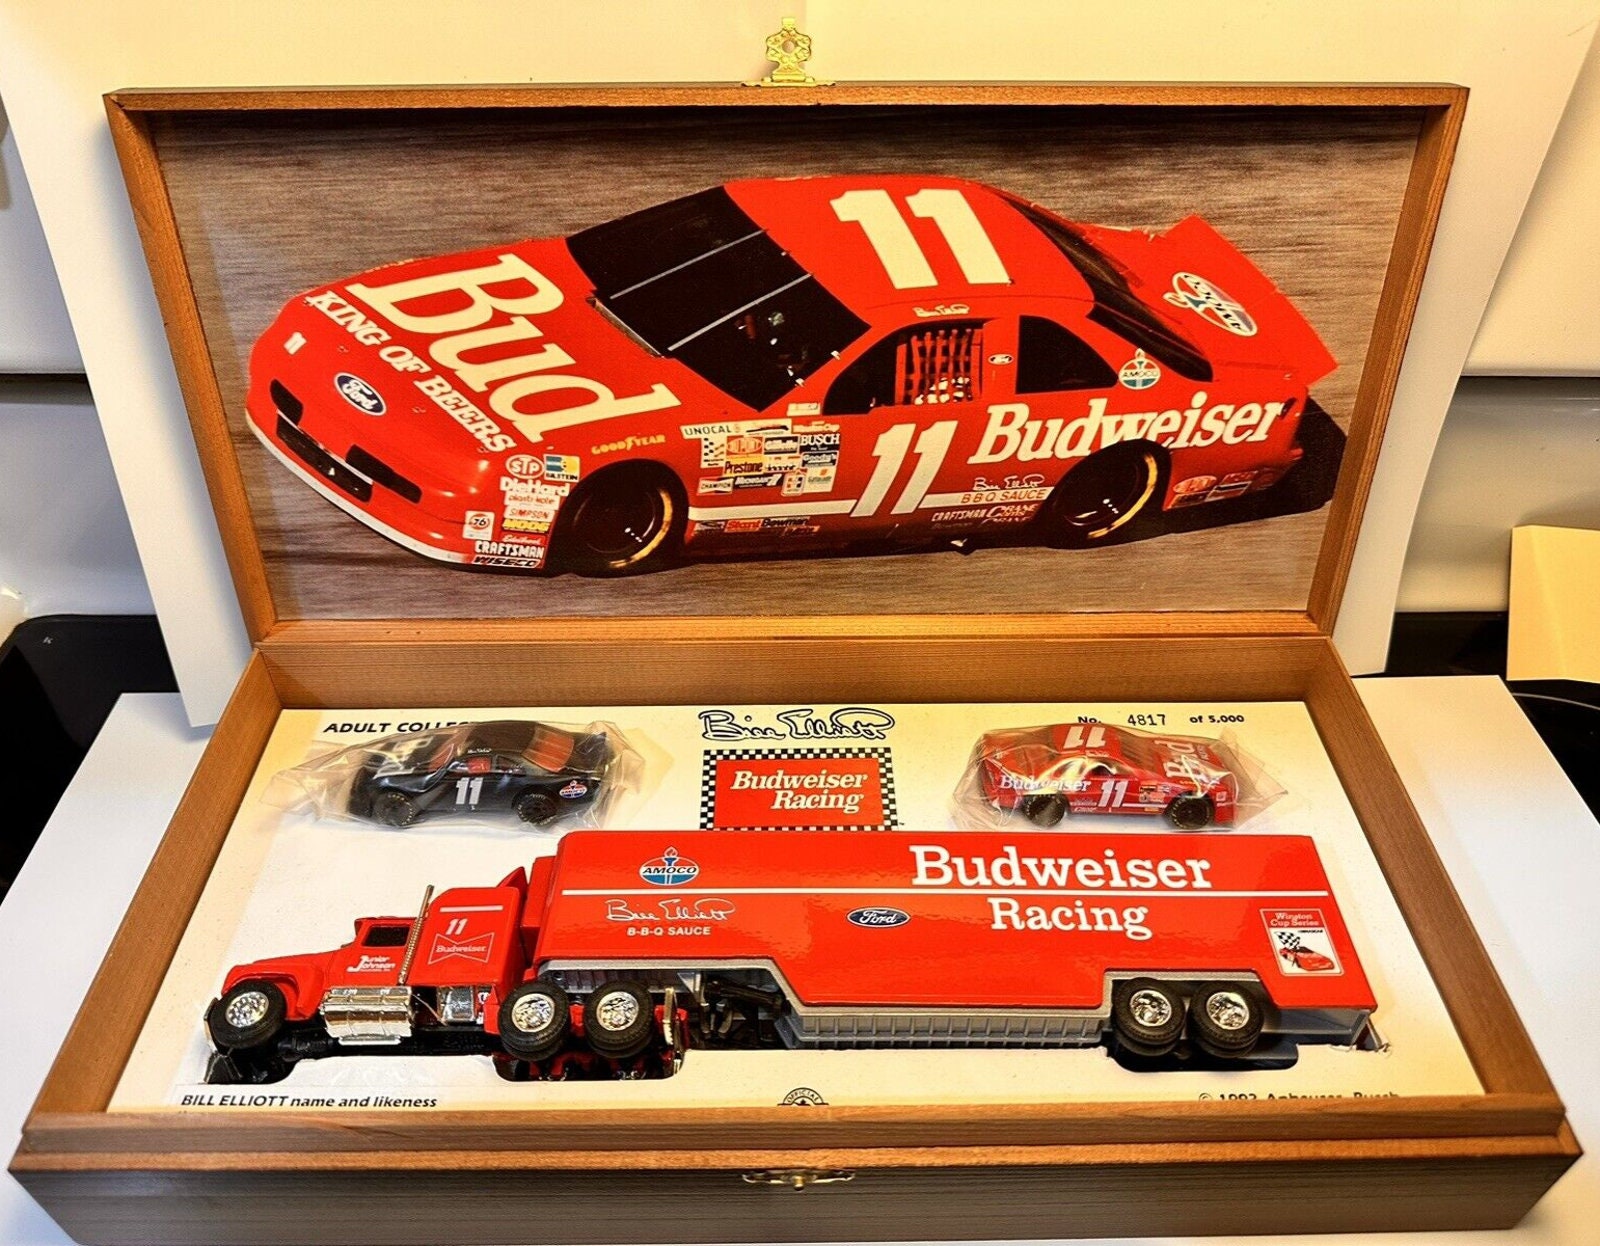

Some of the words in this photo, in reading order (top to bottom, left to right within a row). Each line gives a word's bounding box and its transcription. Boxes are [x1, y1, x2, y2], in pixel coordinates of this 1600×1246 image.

[829, 188, 1012, 290] 11
[345, 252, 683, 445] Bud
[304, 290, 392, 347] KING
[378, 344, 431, 385] OF
[412, 373, 519, 454] BEERS
[341, 376, 387, 413] Ford
[684, 424, 732, 436] UNOCAL
[967, 390, 1286, 466] Budweiser
[590, 433, 667, 456] GOODYEAR
[800, 433, 841, 446] BUSCH
[508, 456, 540, 478] STP
[724, 460, 763, 475] Prestone
[850, 420, 959, 518] 11
[1000, 488, 1048, 501] SAUCE
[474, 539, 545, 559] CRAFTSMAN
[323, 722, 391, 733] ADULT
[1077, 715, 1102, 724] No.
[1127, 714, 1167, 726] 4817
[1189, 715, 1204, 724] of
[729, 769, 869, 791] Budweiser
[455, 776, 484, 805] 11
[1097, 779, 1129, 808] 11
[770, 789, 865, 815] Racing
[641, 865, 698, 875] AMOCO
[909, 844, 1213, 890] Budweiser
[858, 907, 899, 925] Ford
[985, 897, 1153, 941] Racing
[1269, 918, 1291, 928] Cup
[1291, 919, 1320, 927] Series
[1275, 912, 1313, 920] Winston
[445, 918, 468, 936] 11
[626, 926, 664, 937] B-B-Q
[667, 925, 711, 937] SAUCE
[436, 944, 487, 954] Budweiser
[180, 1094, 215, 1107] BILL
[218, 1095, 289, 1108] ELLIOTT
[289, 1096, 335, 1108] name
[337, 1096, 371, 1108] and
[373, 1096, 438, 1109] likeness
